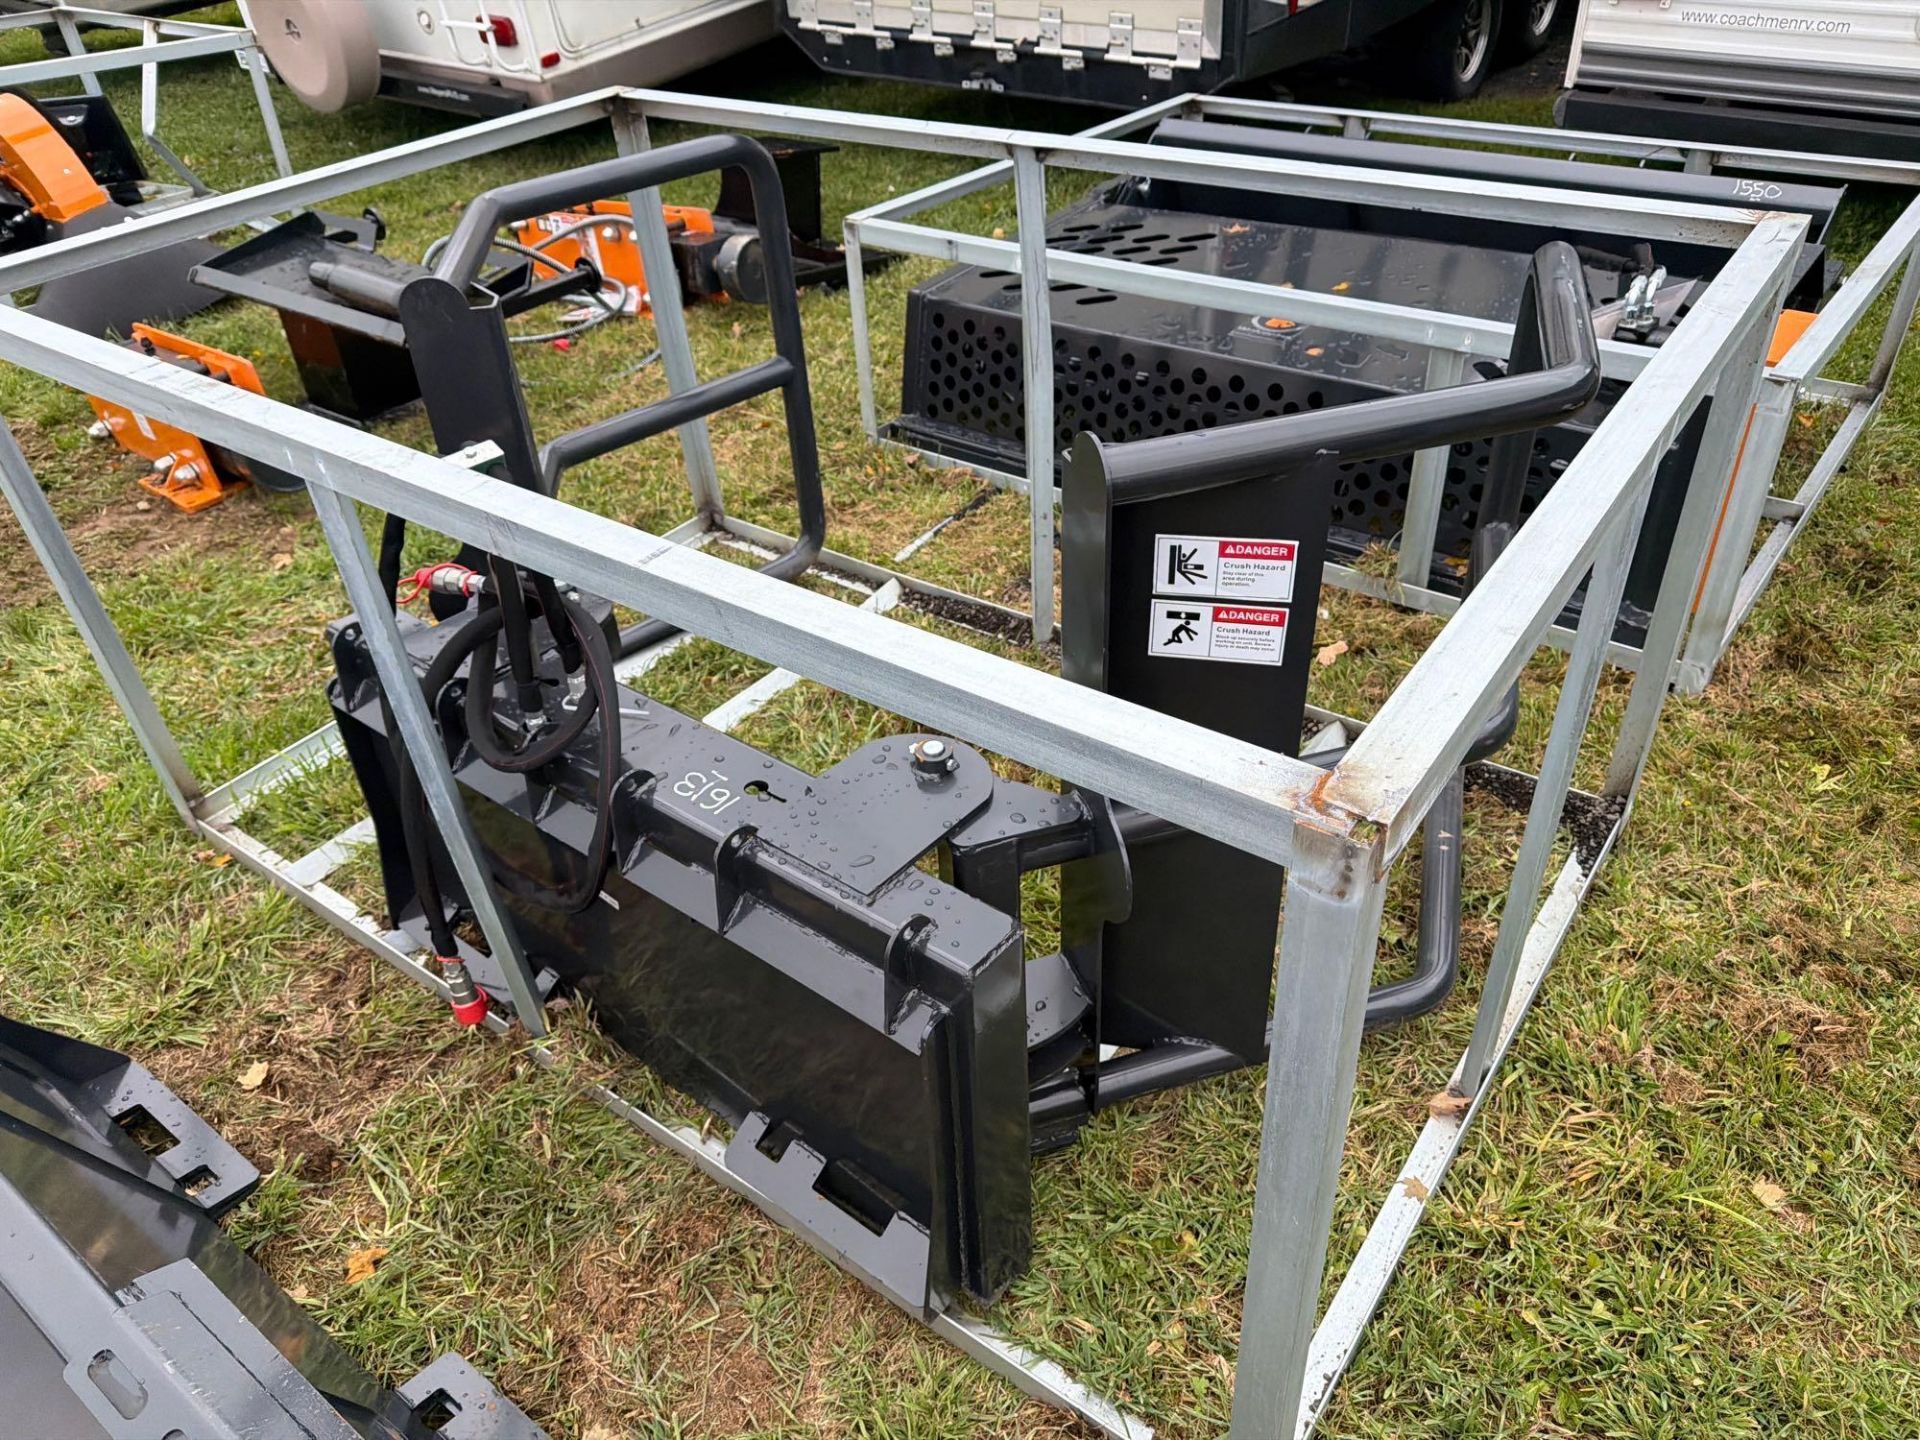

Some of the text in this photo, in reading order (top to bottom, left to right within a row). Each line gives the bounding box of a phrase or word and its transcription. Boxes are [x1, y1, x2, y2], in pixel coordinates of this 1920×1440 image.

[1681, 10, 1851, 34] www.coachmenrv.com
[1732, 179, 1783, 200] 1550
[1236, 545, 1288, 556] DANGER
[1229, 612, 1279, 622] DANGER
[673, 770, 741, 815] 1613
